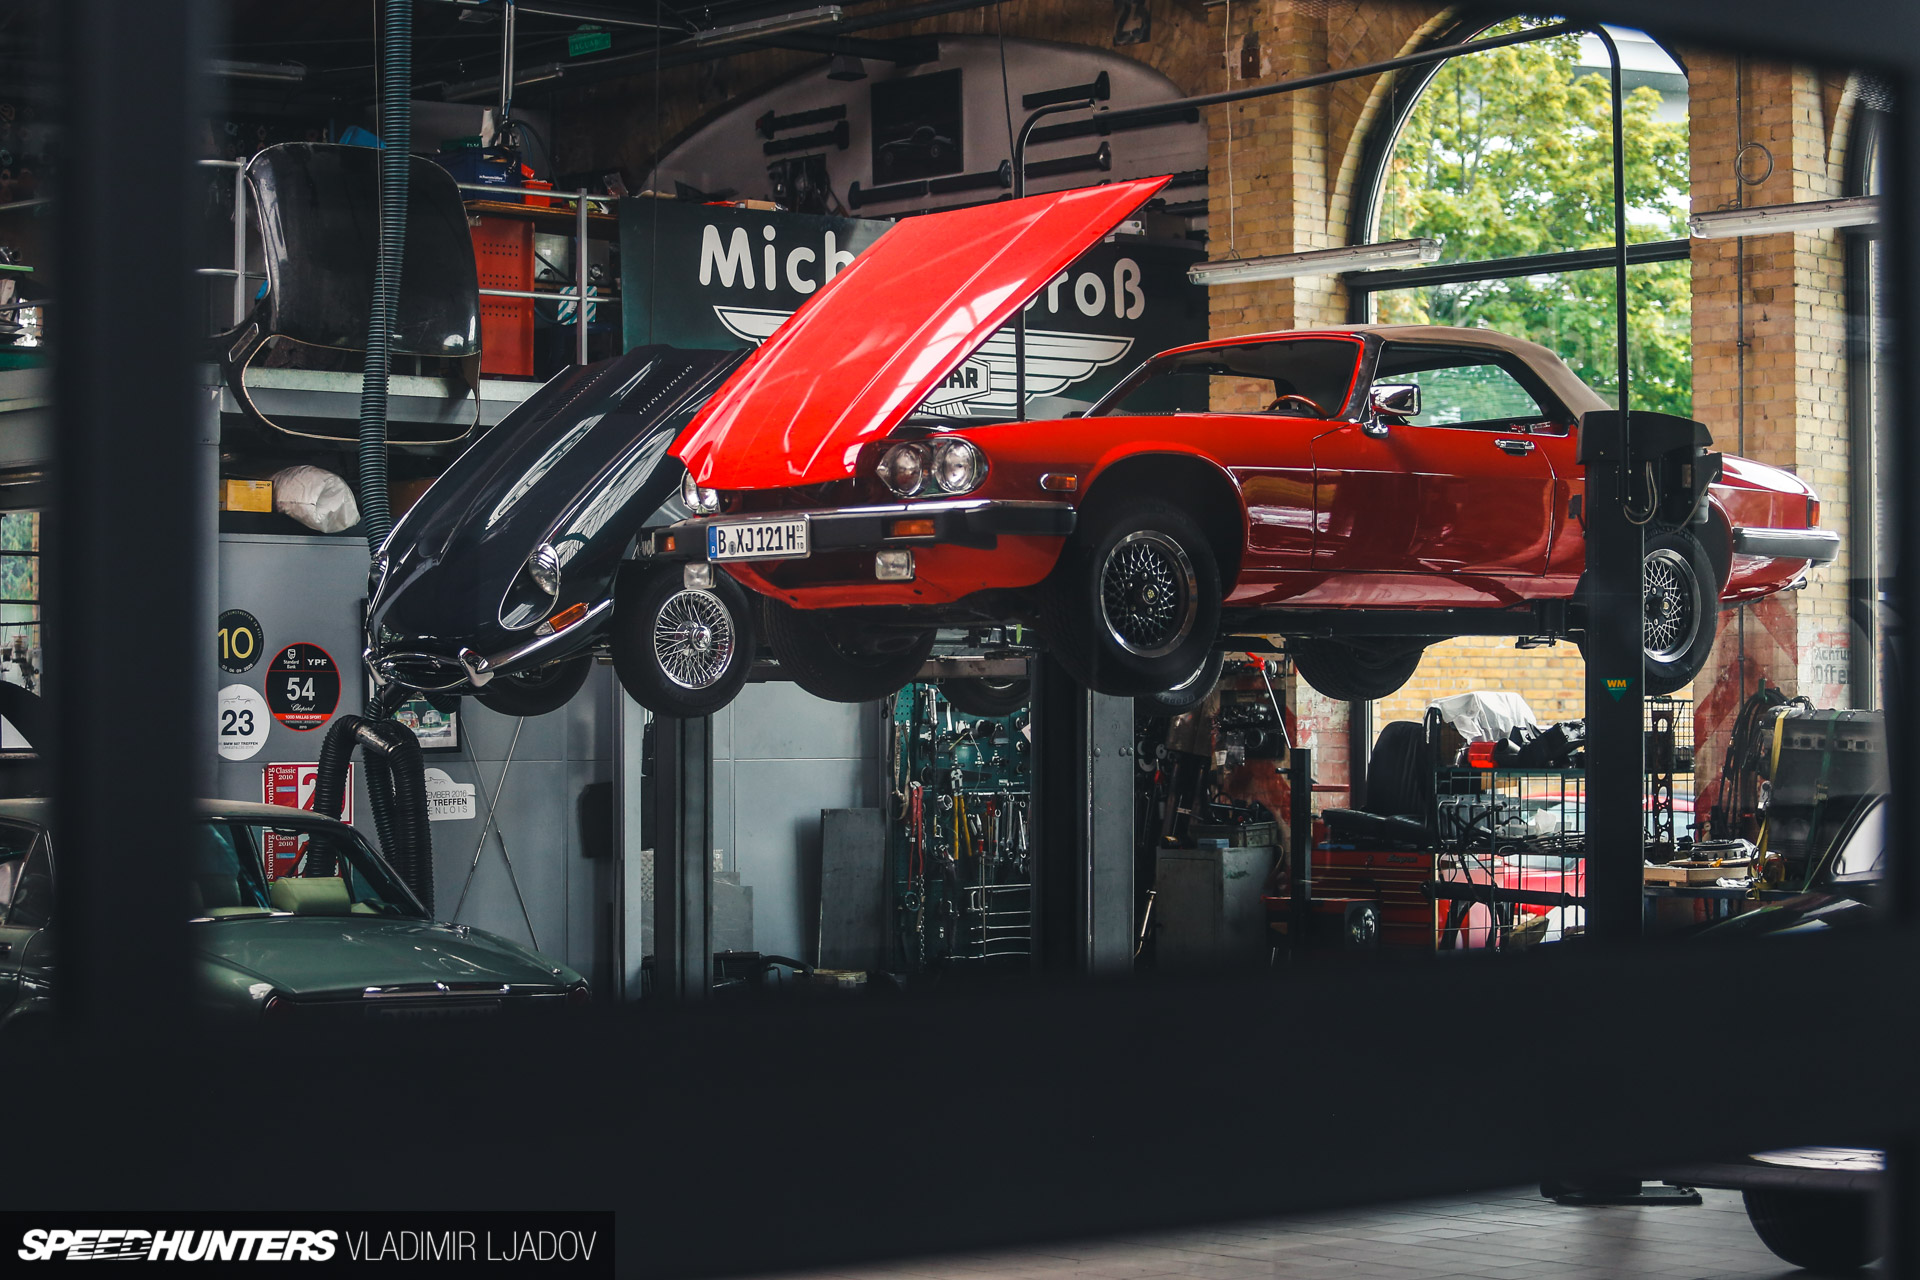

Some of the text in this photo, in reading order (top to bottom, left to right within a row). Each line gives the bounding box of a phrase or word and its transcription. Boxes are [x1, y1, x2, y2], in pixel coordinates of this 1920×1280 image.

[699, 224, 1146, 320] Mich roß
[718, 530, 727, 554] B
[217, 627, 254, 659] 10
[307, 658, 328, 666] YPF
[286, 677, 316, 701] 54
[1607, 679, 1627, 688] WM
[290, 703, 316, 713] Chopard
[221, 709, 255, 736] 23
[275, 767, 296, 775] Classic
[266, 767, 276, 805] romburg
[427, 791, 450, 799] EMBER
[433, 798, 467, 807] TREFFEN
[428, 806, 468, 815] ENLOIS
[266, 835, 275, 880] Stromburg
